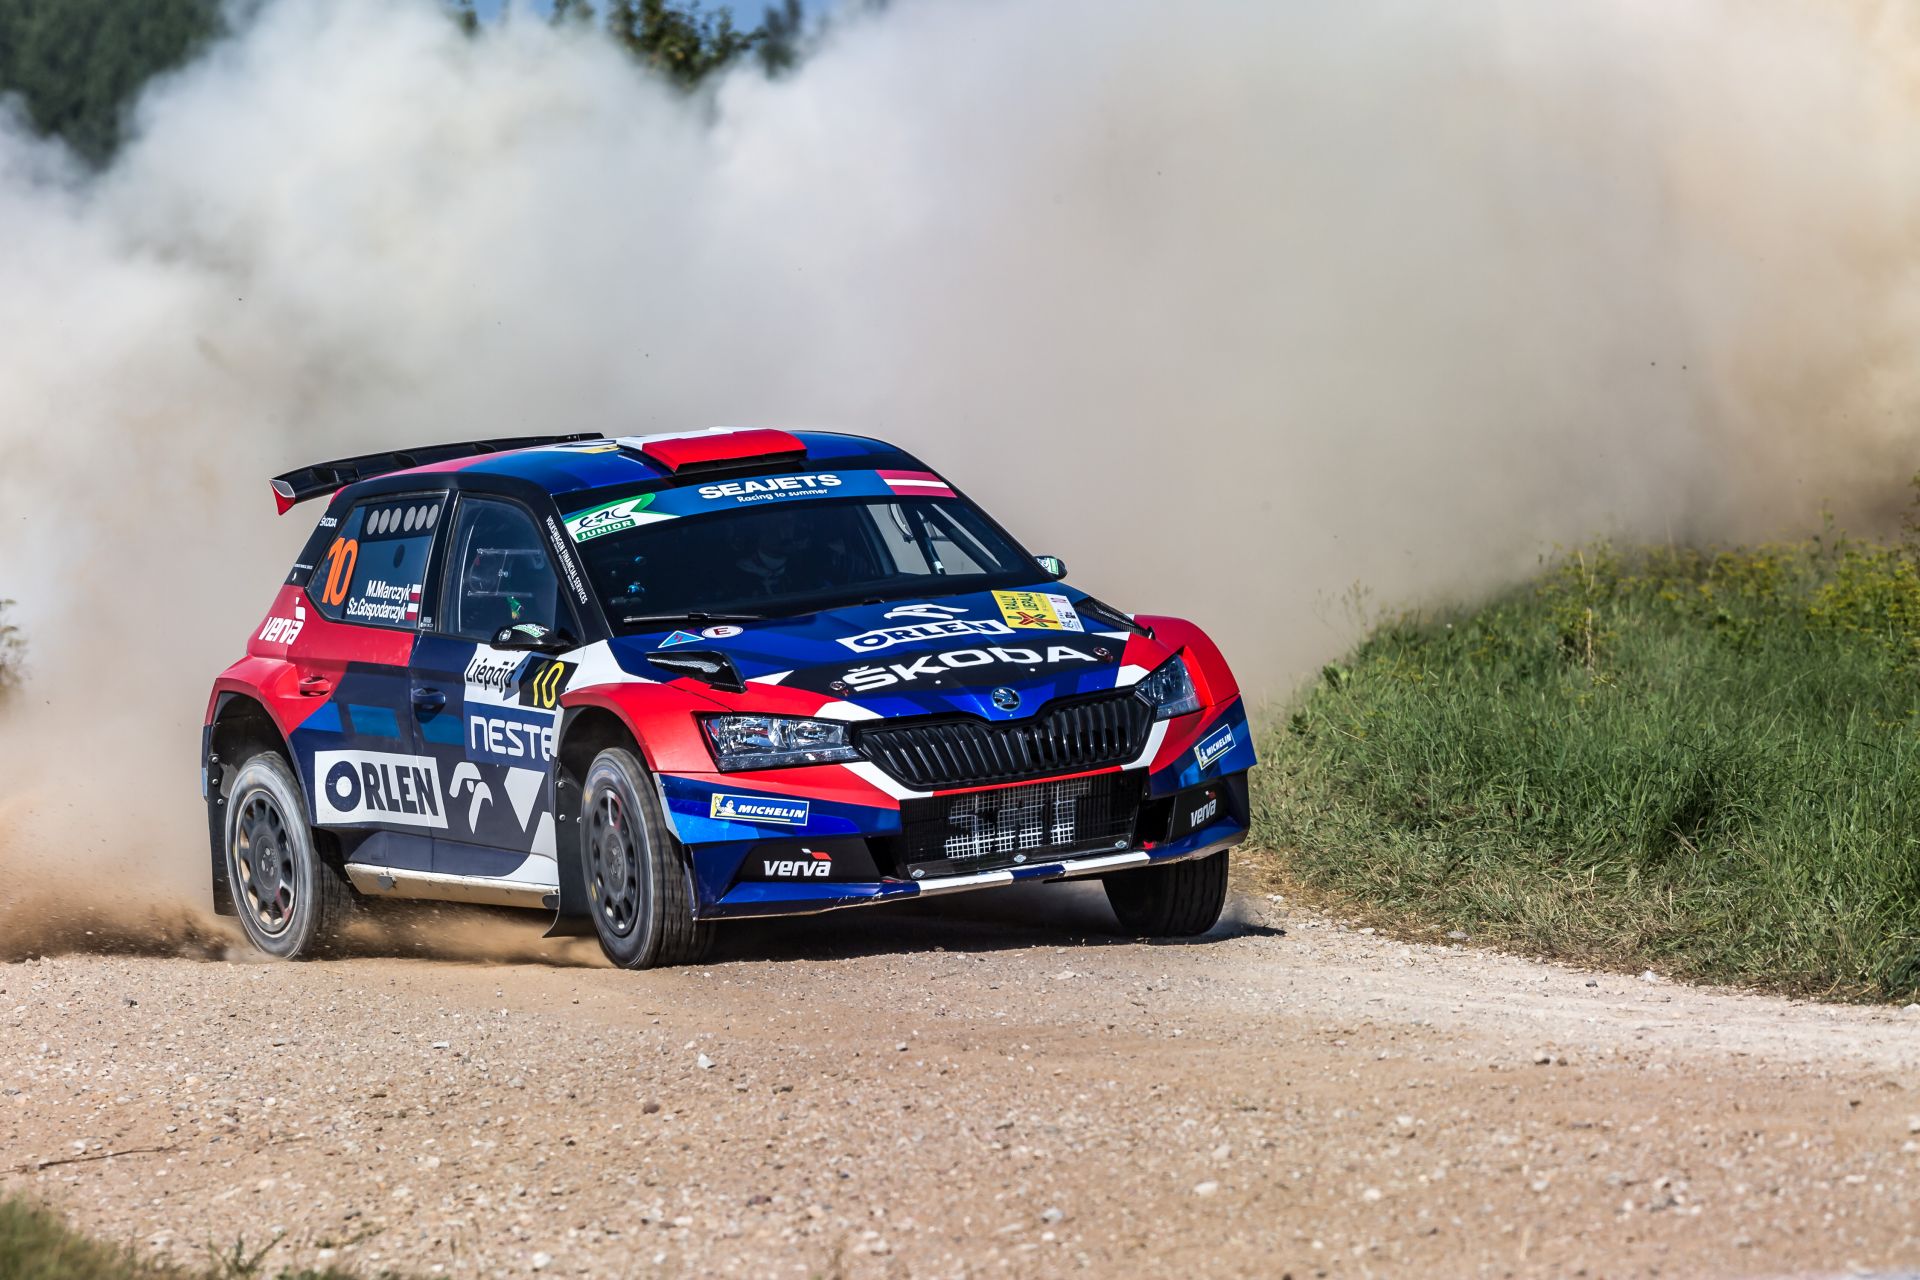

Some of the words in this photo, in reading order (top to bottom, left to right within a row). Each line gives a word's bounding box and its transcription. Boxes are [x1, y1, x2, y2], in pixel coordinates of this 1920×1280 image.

[698, 474, 843, 499] SEAJETS
[737, 491, 774, 503] Racing
[788, 488, 828, 496] summer
[581, 520, 633, 539] JUNIOR
[321, 537, 359, 606] 10
[546, 515, 566, 555] VOLKSWAGEN
[561, 549, 578, 580] FINANCIAL
[573, 575, 588, 605] SERVICES
[365, 579, 412, 603] M.Marczyk
[346, 597, 407, 624] Sz.Gospodarczyk
[258, 616, 305, 646] verva
[713, 627, 732, 636] E
[852, 620, 996, 647] ORLEN
[842, 645, 1099, 692] ŠKODA
[532, 659, 565, 709] 10
[1206, 733, 1232, 757] MICHELIN
[325, 760, 440, 816] ORLEN
[737, 804, 806, 818] MICHELIN
[1190, 799, 1217, 827] verva
[763, 860, 832, 877] verva
